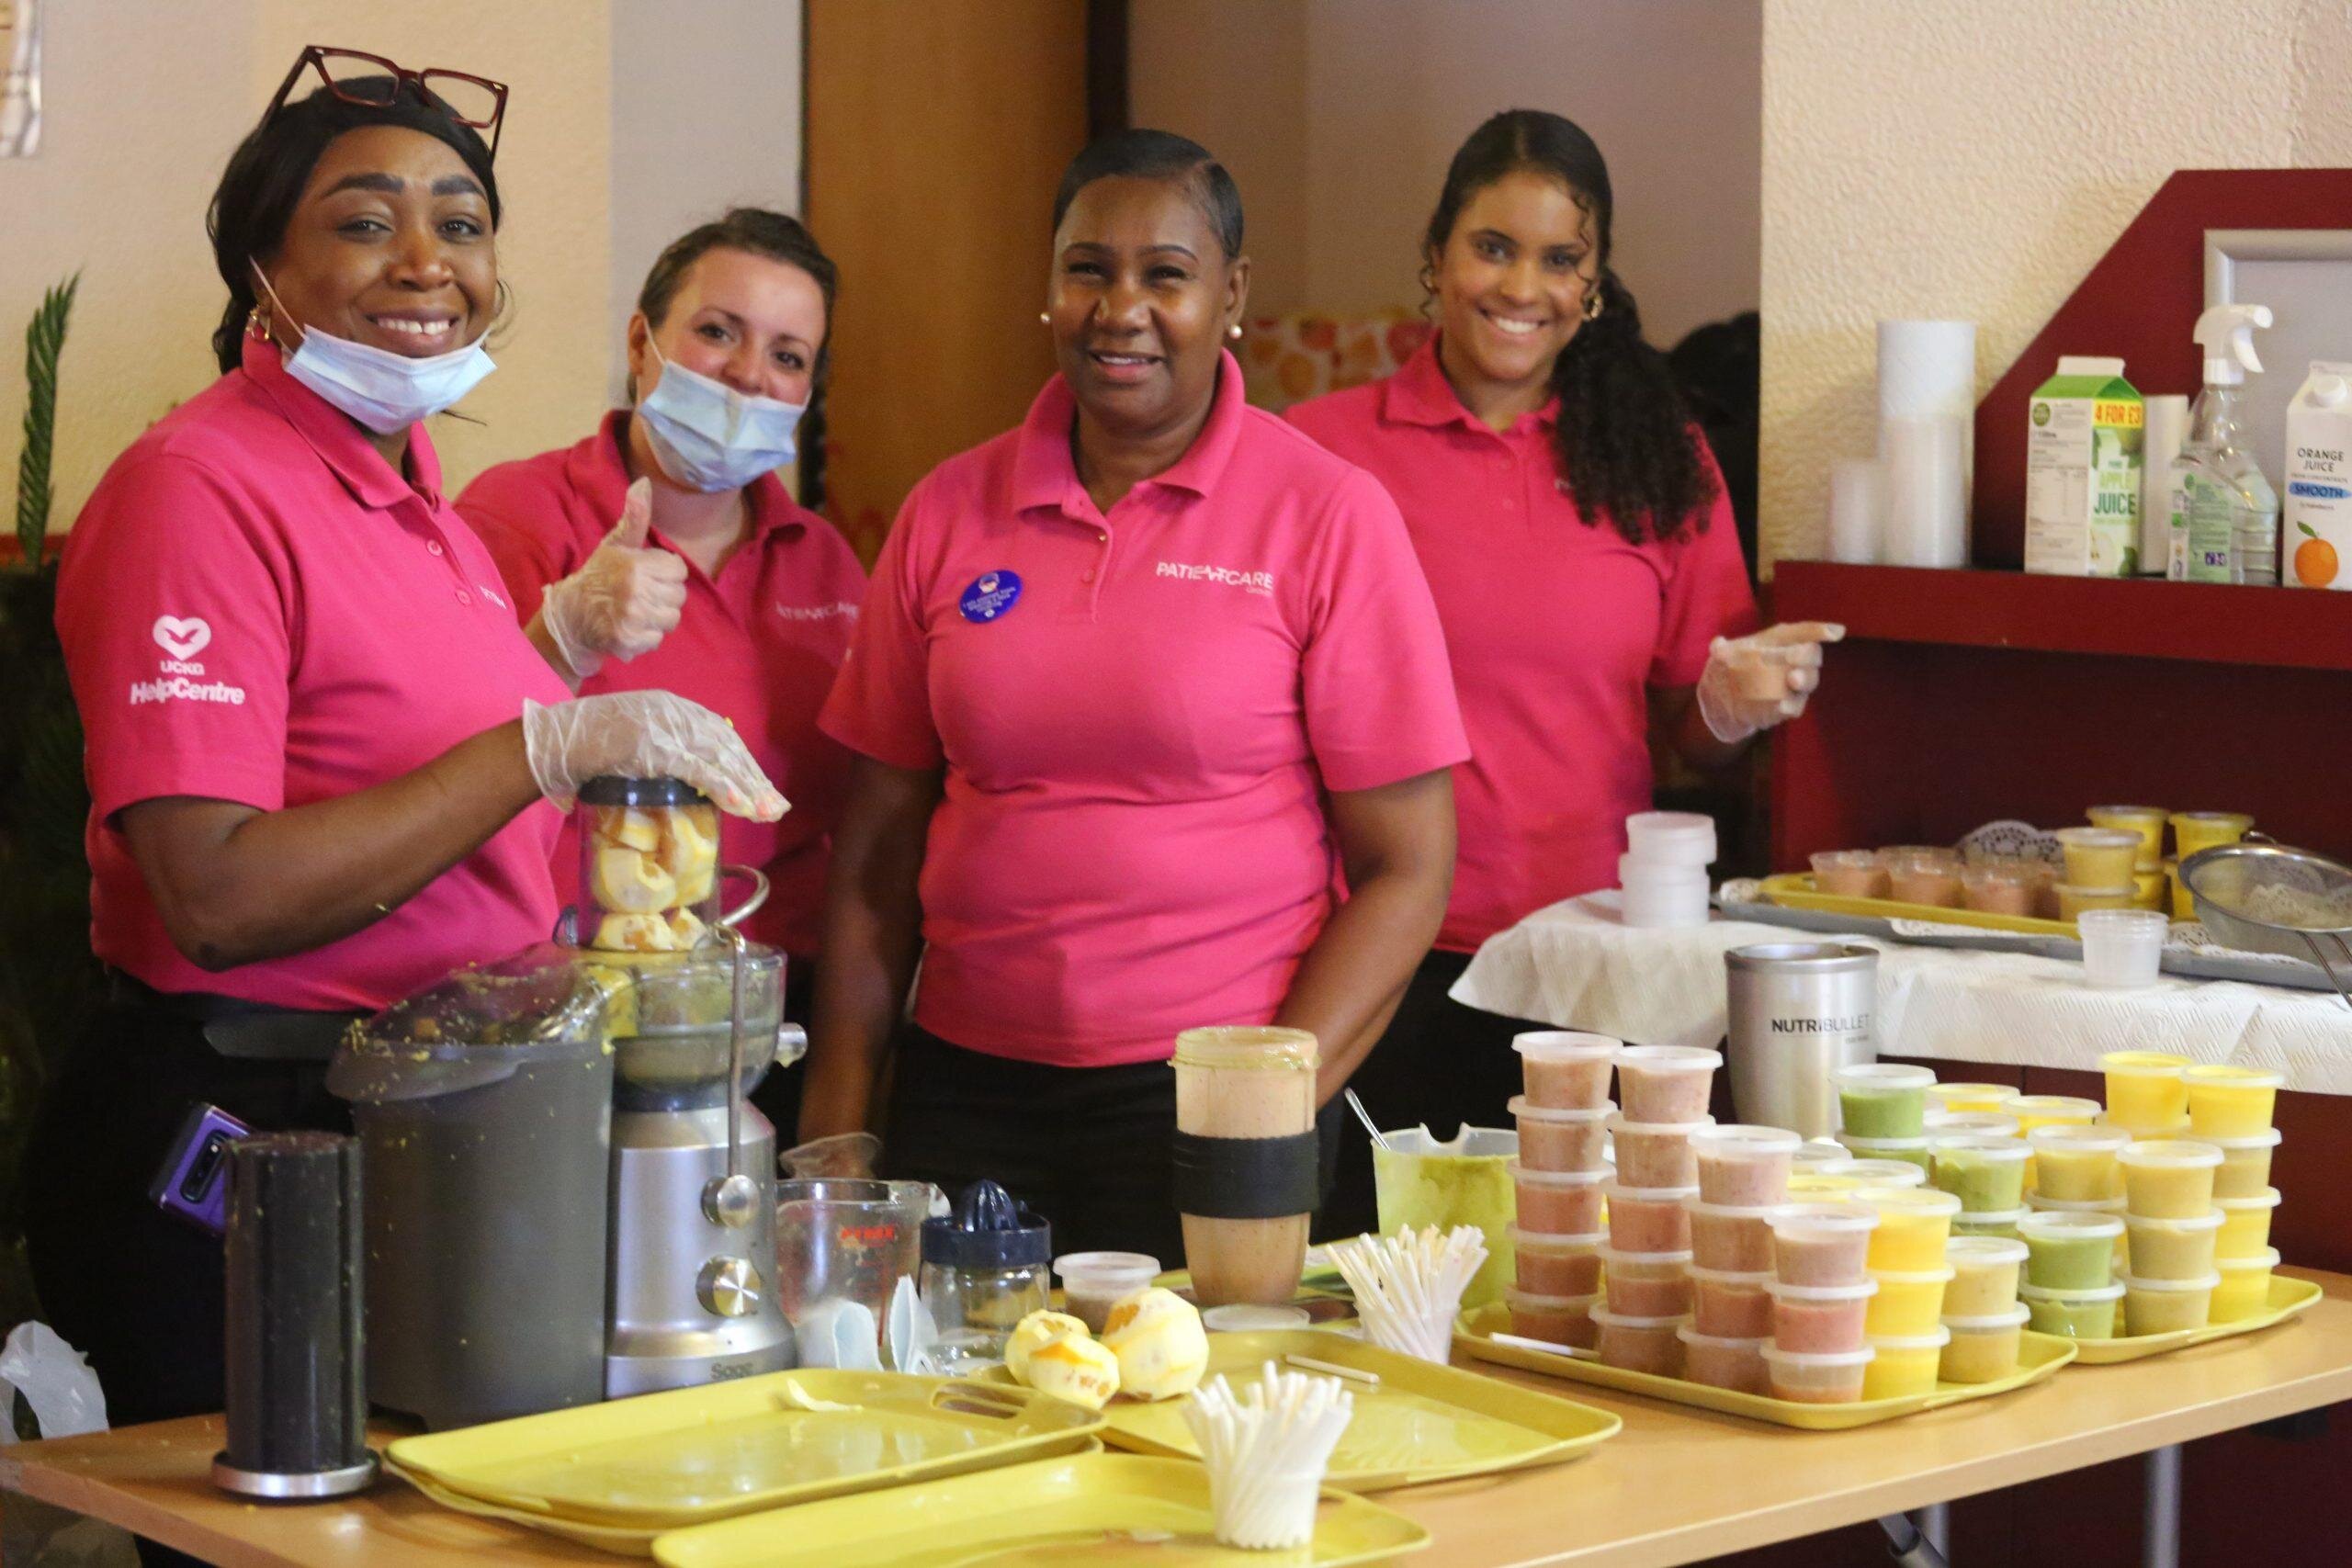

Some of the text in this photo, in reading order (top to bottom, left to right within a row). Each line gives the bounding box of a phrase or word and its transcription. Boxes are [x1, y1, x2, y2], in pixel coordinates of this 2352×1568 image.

[2105, 404, 2125, 424] FOR
[2297, 447, 2345, 462] ORANGE
[2302, 459, 2335, 472] JUICE
[2294, 484, 2345, 498] SMOOTH
[2094, 492, 2137, 515] JUICE
[130, 678, 245, 705] HelpCentre
